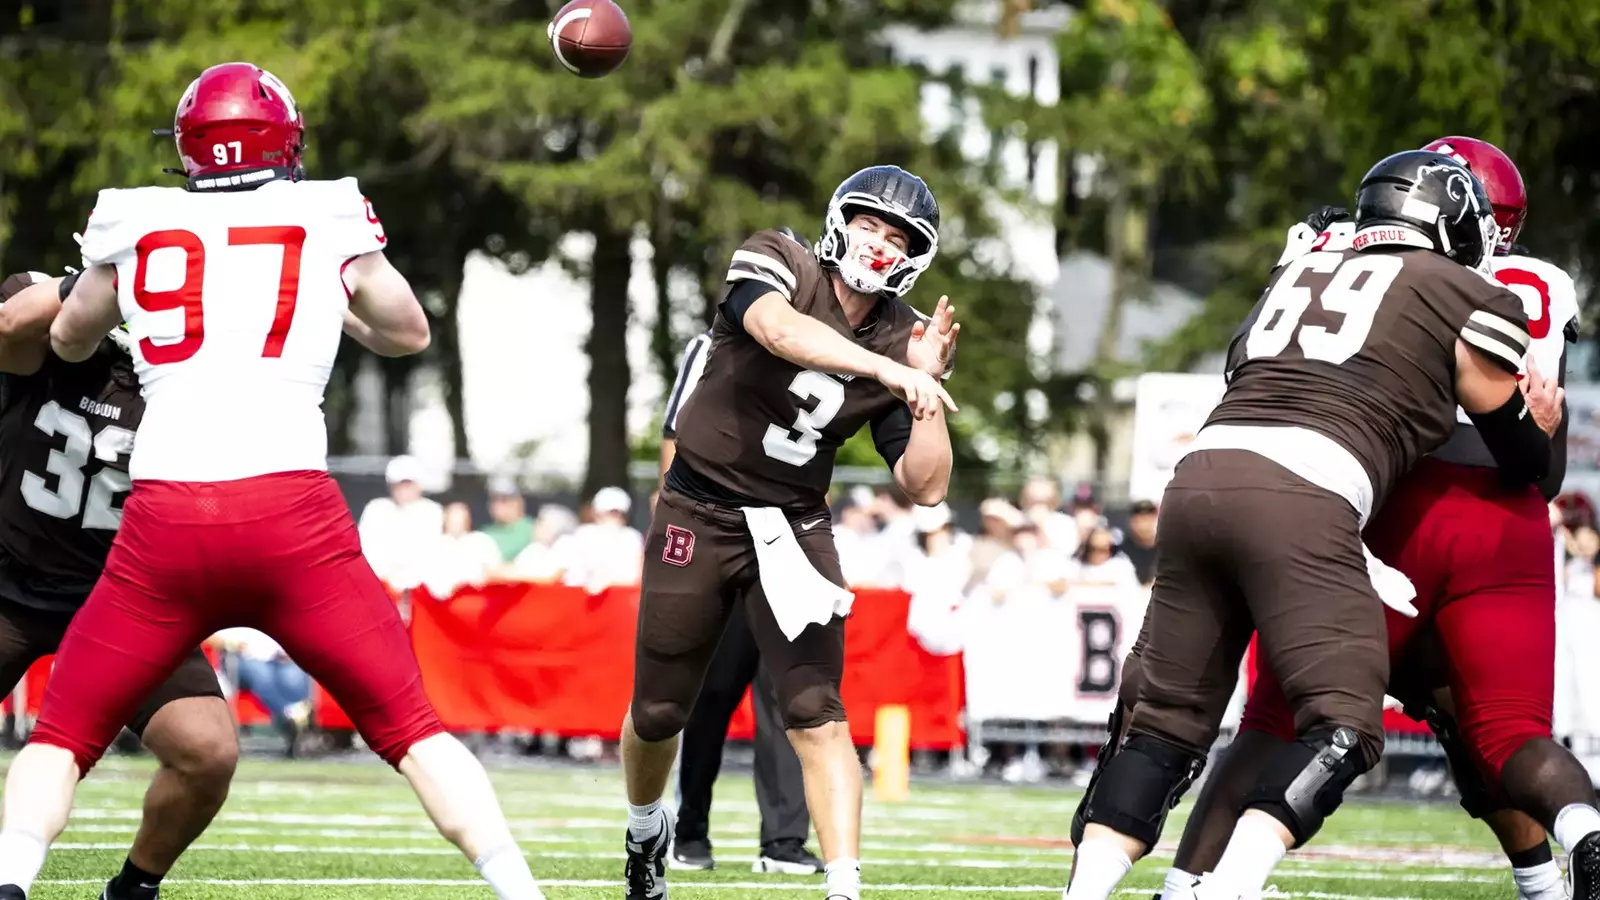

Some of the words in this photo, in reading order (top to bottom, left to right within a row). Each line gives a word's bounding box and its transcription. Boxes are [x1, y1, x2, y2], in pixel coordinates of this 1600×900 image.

[213, 141, 242, 165] 97
[1370, 229, 1406, 243] TRUE
[133, 225, 307, 366] 97
[1246, 252, 1404, 366] 69
[79, 396, 121, 420] BROWN
[762, 369, 845, 467] 3
[20, 400, 136, 530] 32
[662, 524, 696, 567] B
[1076, 604, 1122, 699] B
